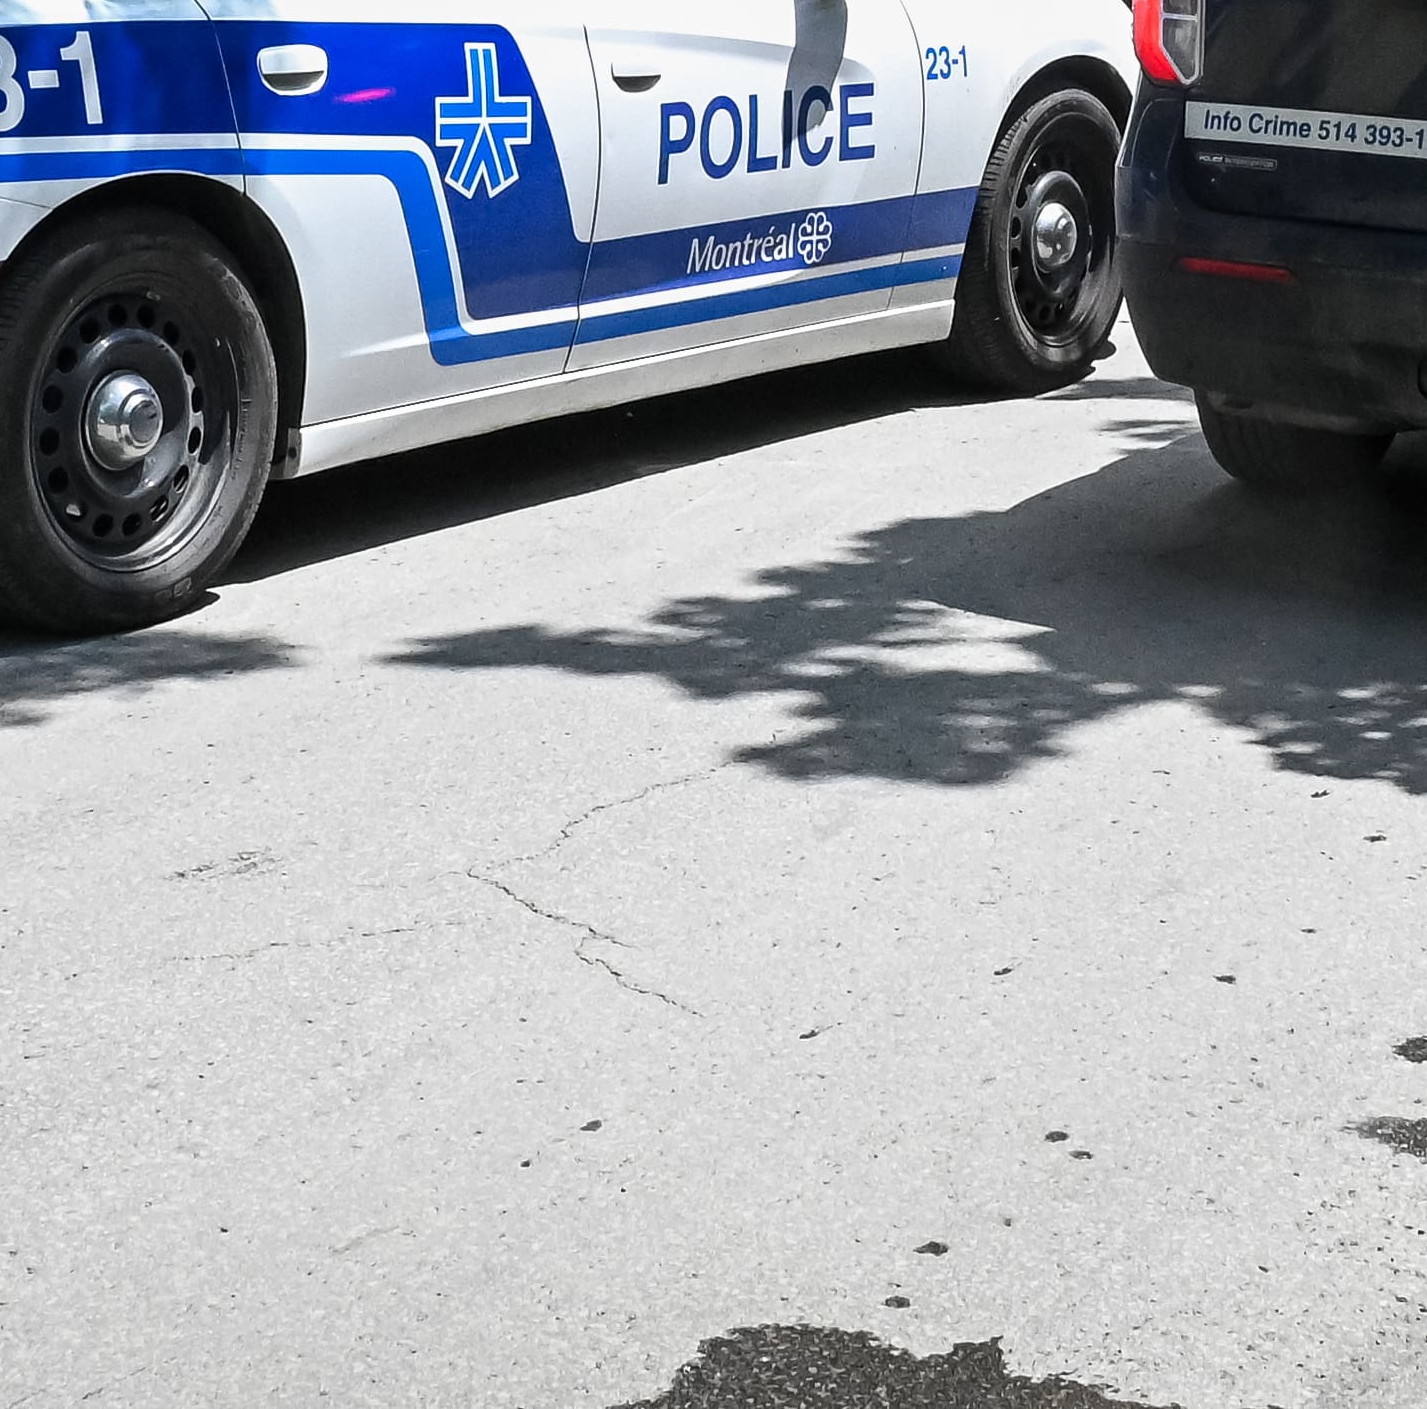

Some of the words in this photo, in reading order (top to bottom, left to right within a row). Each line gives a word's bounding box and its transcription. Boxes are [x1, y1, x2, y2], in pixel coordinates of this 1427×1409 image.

[925, 45, 969, 80] 23-1
[657, 82, 876, 184] POLICE
[1203, 109, 1242, 132] Info
[1248, 112, 1312, 139] Crime
[1317, 119, 1358, 143] 514
[686, 222, 796, 275] Montréal
